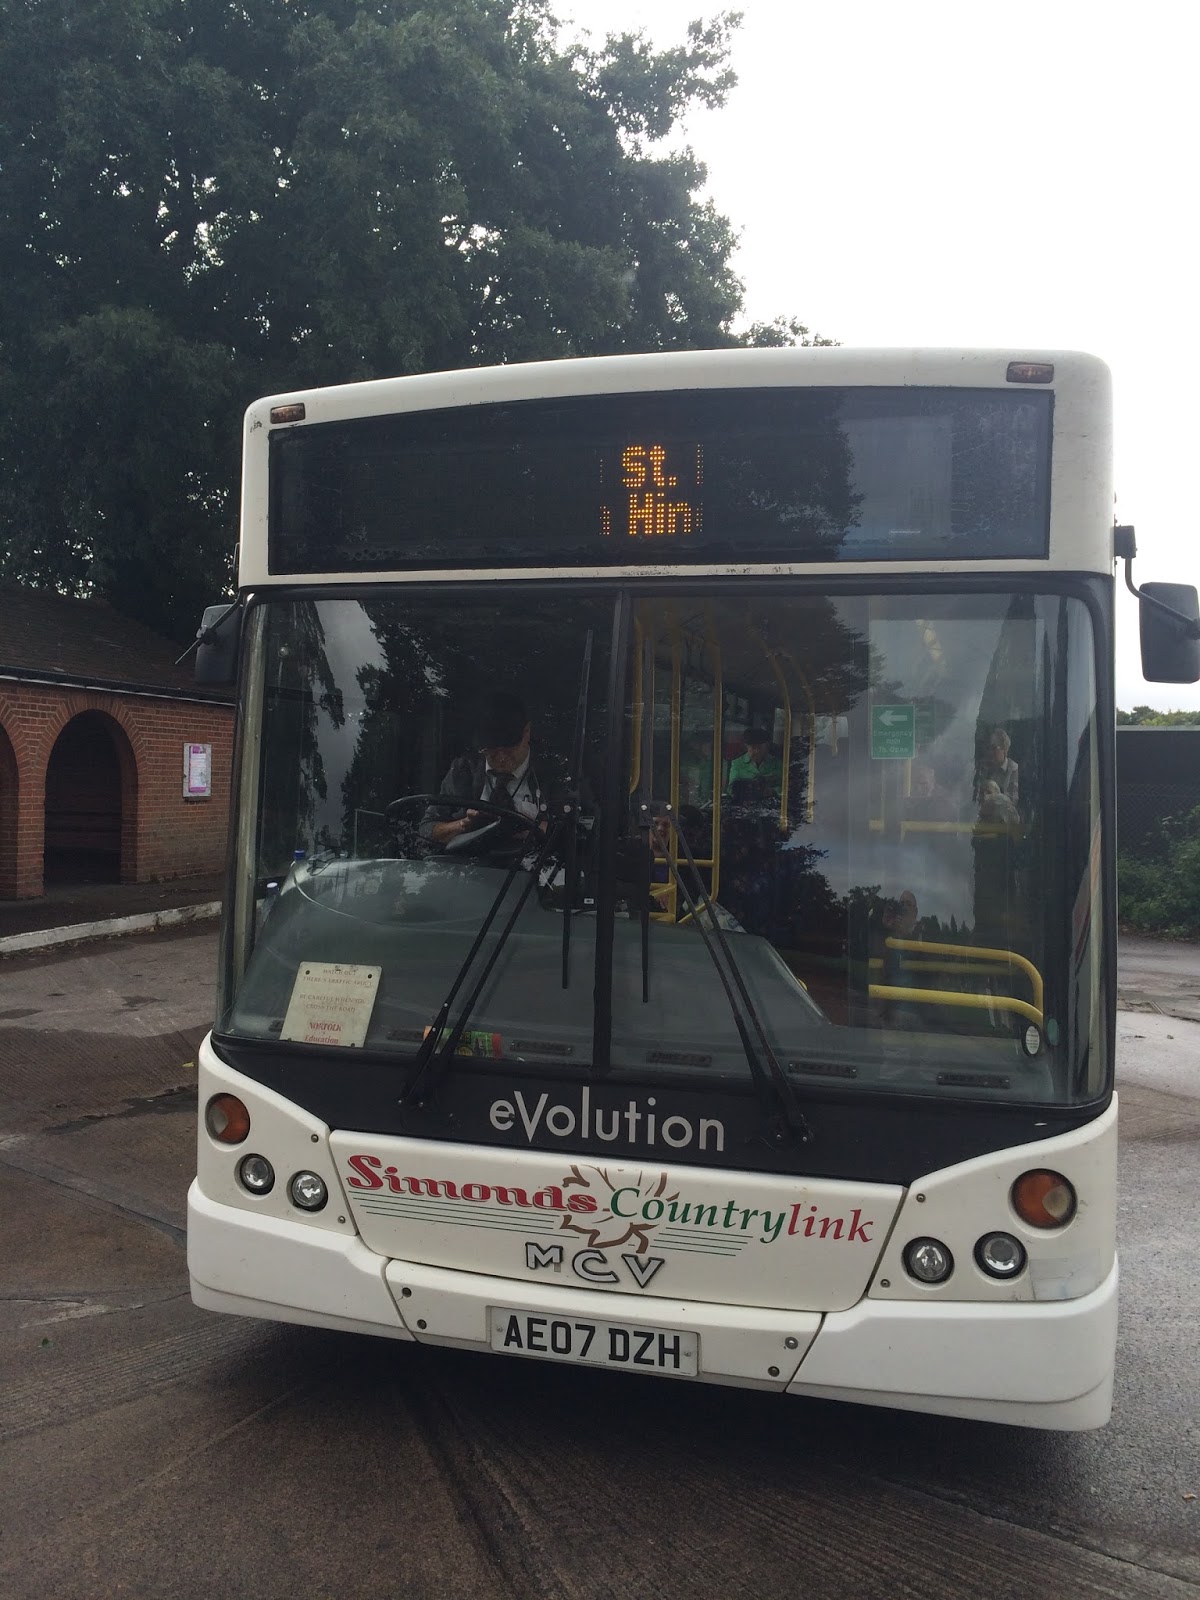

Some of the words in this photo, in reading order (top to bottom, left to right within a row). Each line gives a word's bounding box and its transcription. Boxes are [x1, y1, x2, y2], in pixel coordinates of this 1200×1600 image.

[304, 1034, 339, 1044] Education
[309, 1022, 342, 1032] NORFOLK
[489, 1086, 724, 1152] eVolution
[346, 1154, 598, 1213] Simonds
[610, 1187, 874, 1244] Countrylink
[503, 1314, 597, 1359] AE07
[608, 1327, 682, 1369] DZH
